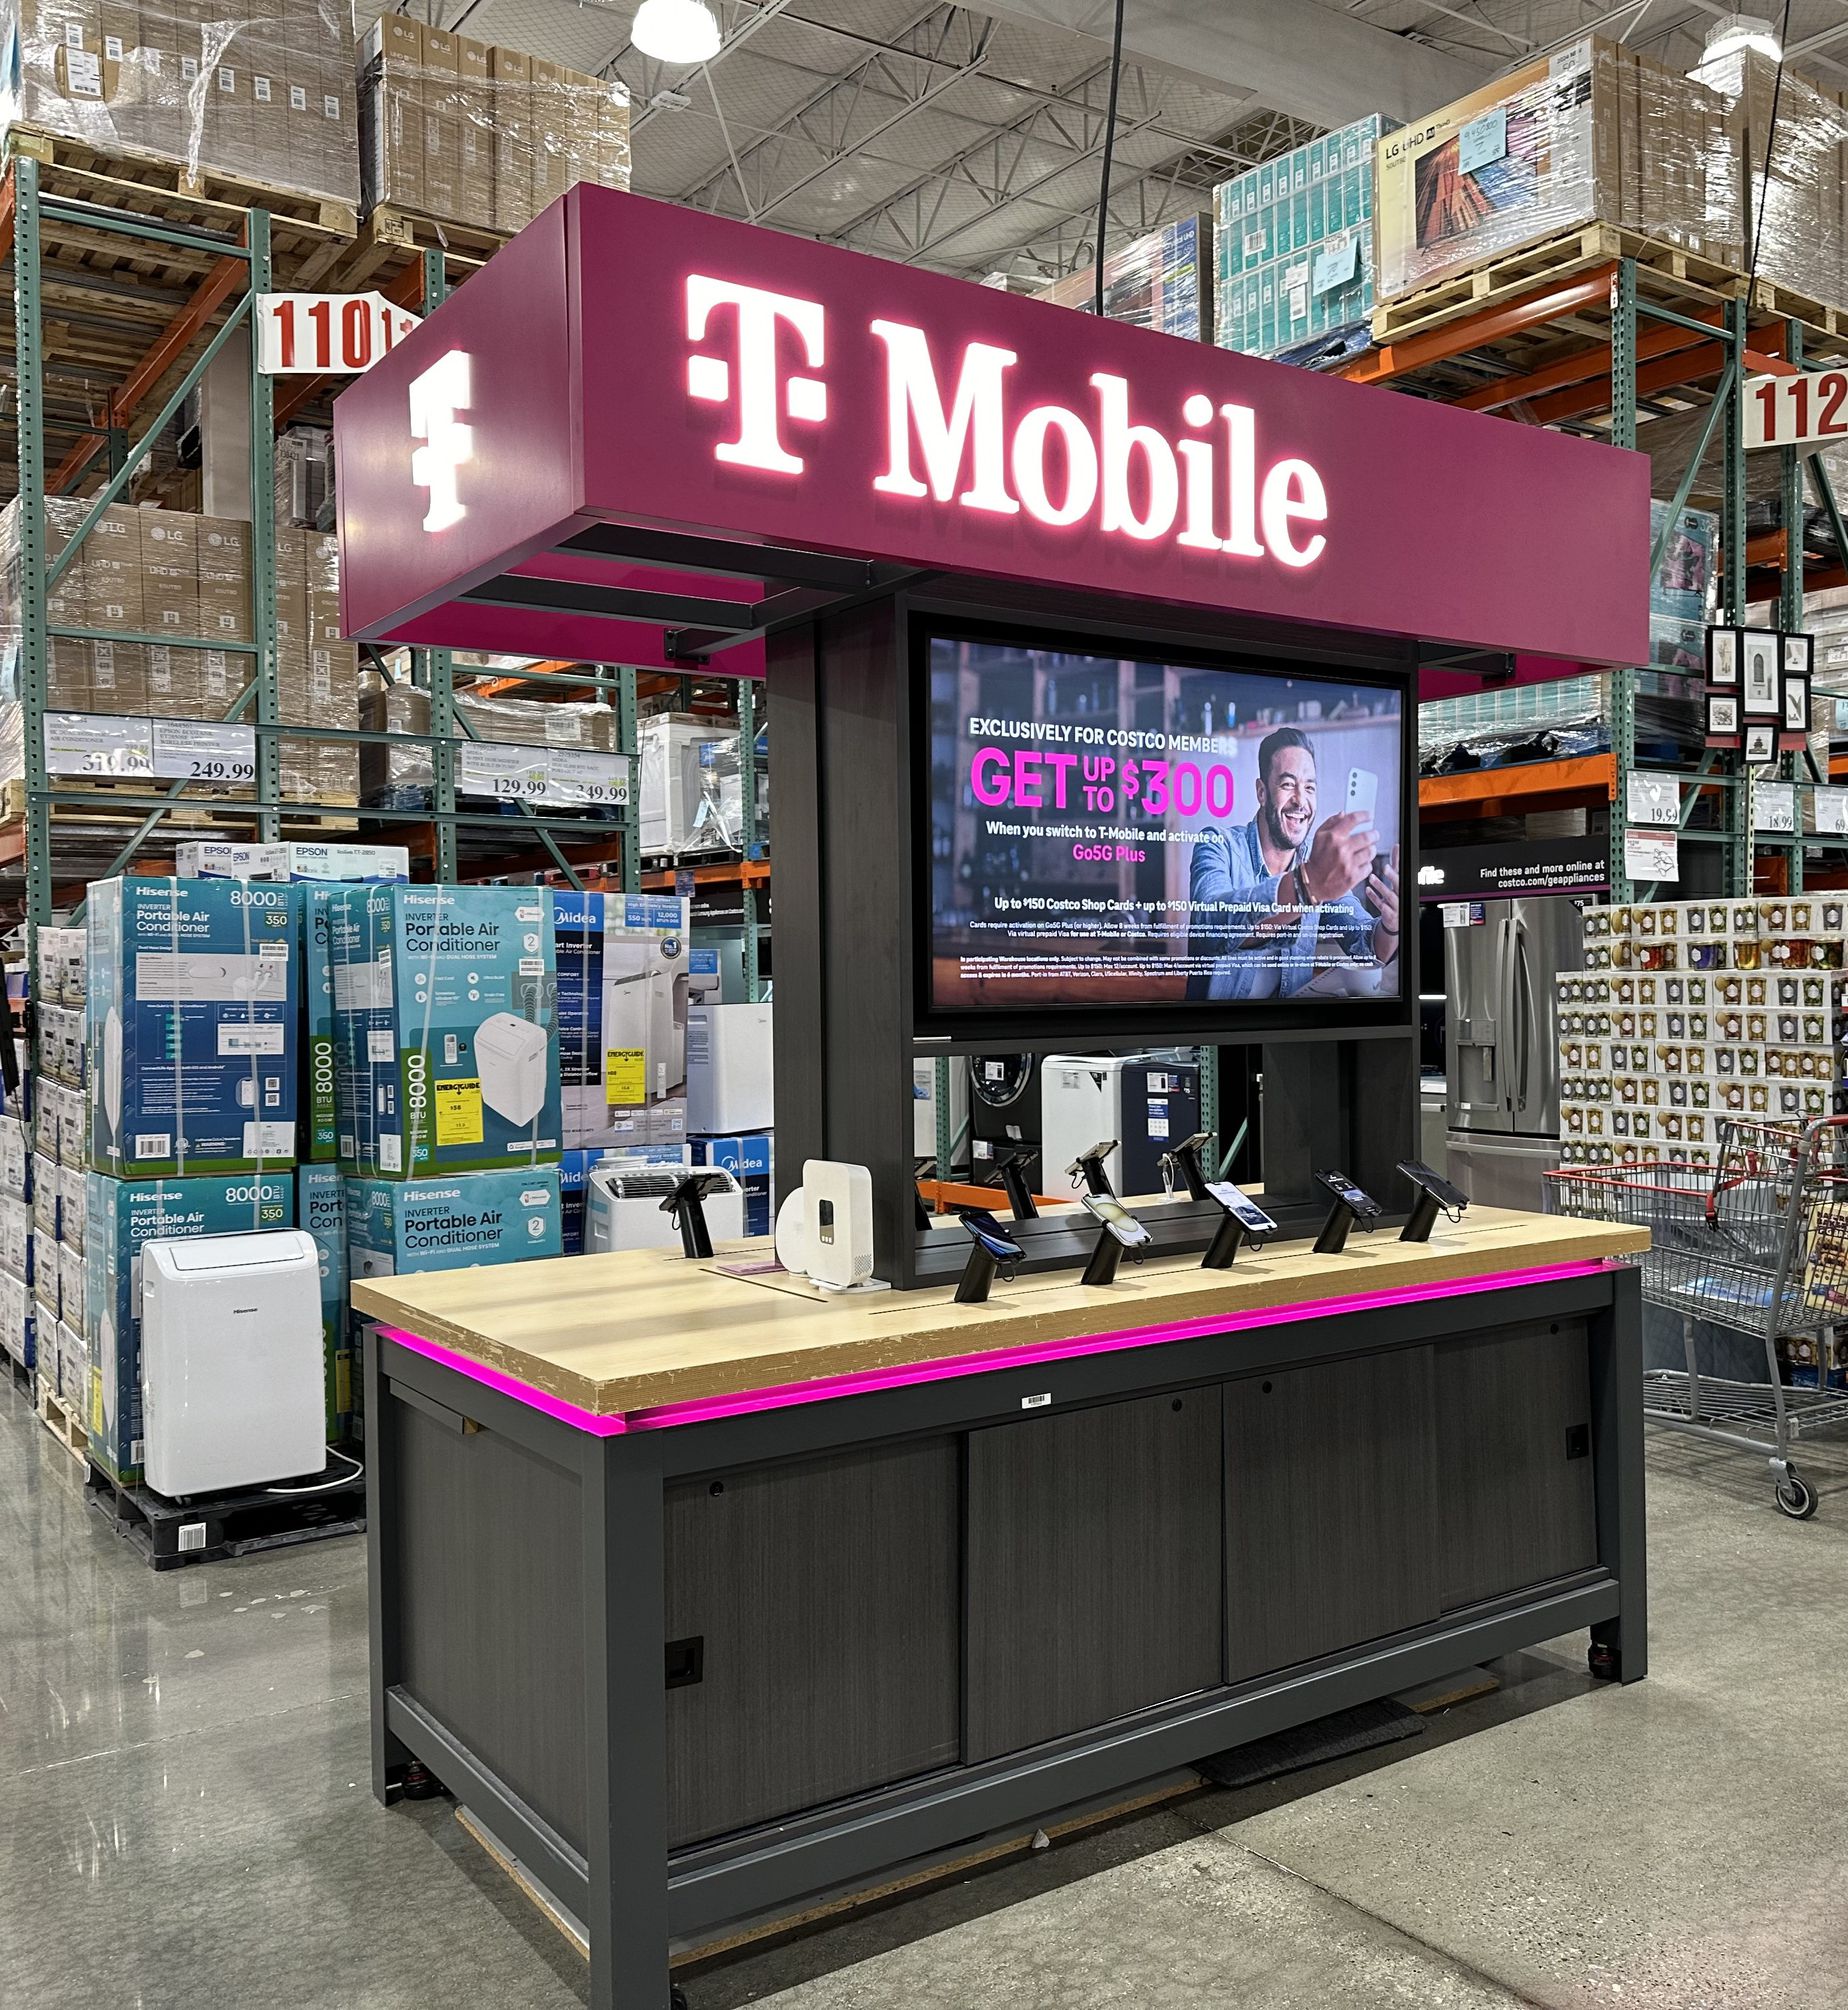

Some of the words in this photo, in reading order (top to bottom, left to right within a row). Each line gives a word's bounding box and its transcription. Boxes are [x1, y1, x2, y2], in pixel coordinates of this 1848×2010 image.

[404, 31, 414, 39] LG
[440, 42, 450, 50] LG
[1386, 144, 1398, 159] LG
[273, 300, 371, 368] 110
[1756, 373, 1848, 441] 112
[685, 274, 827, 475] T
[870, 317, 1329, 569] Mobile
[108, 523, 125, 533] LG
[168, 531, 182, 540] LG
[224, 538, 239, 546] LG
[970, 717, 1072, 742] EXCLUSIVELY
[1074, 726, 1104, 744] FOR
[1107, 729, 1165, 749] COSTCO
[190, 762, 253, 779] 249.99
[1083, 756, 1115, 782] UP
[970, 747, 1077, 809] GET
[493, 779, 546, 795] 129.99
[576, 784, 627, 801] 349.99
[1122, 759, 1234, 818] $300
[1083, 785, 1114, 813] TO
[986, 821, 1021, 835] When
[1022, 825, 1044, 839] you
[1046, 824, 1082, 838] switch
[1085, 826, 1097, 838] to
[1098, 826, 1145, 840] T-Mobile
[1147, 829, 1166, 842] and
[1168, 830, 1210, 843] activate
[1211, 833, 1224, 843] on
[233, 852, 250, 862] EPSON
[297, 848, 327, 856] EPSON
[1072, 844, 1112, 861] Go5G
[1116, 846, 1146, 862] Plus
[1481, 868, 1497, 878] Find
[1499, 866, 1522, 877] these
[1524, 864, 1540, 875] and
[1542, 865, 1563, 874] more
[1566, 861, 1593, 872] online
[1595, 860, 1605, 870] at
[1498, 872, 1605, 888] costco.com/geappliances
[136, 887, 188, 897] Hisense
[230, 891, 277, 906] 8000
[404, 895, 455, 904] Hisense
[367, 898, 385, 913] 8000
[995, 897, 1008, 911] Up
[1010, 898, 1022, 909] to
[1023, 898, 1045, 909] $150
[1046, 898, 1080, 910] Costco
[1082, 899, 1106, 912] Shop
[1107, 899, 1134, 911] Cards
[1143, 901, 1155, 912] up
[1156, 900, 1166, 911] to
[1168, 901, 1187, 911] $150
[1188, 901, 1218, 912] Virtual
[1219, 902, 1251, 914] Prepaid
[1252, 902, 1270, 912] Visa
[1271, 902, 1291, 913] Card
[1292, 903, 1314, 913] when
[1315, 903, 1354, 915] activating
[137, 911, 189, 921] Portable
[192, 911, 209, 921] Air
[266, 916, 287, 924] 350
[555, 907, 596, 924] Midea
[137, 922, 209, 932] Conditioner
[406, 923, 474, 936] Porable
[479, 922, 499, 936] Air
[1037, 930, 1057, 938] prepaid
[407, 937, 500, 951] Conditioner
[528, 937, 535, 946] 2
[315, 1043, 333, 1092] 8000
[408, 1055, 426, 1108] 8000
[130, 1192, 183, 1202] Hisense
[226, 1186, 273, 1202] 8000
[404, 1188, 461, 1201] Hisense
[131, 1214, 185, 1226] Portable
[187, 1212, 204, 1223] Air
[262, 1209, 283, 1219] 350
[405, 1206, 450, 1218] INVERTER
[405, 1214, 476, 1232] Portable
[479, 1211, 502, 1224] Air
[532, 1220, 540, 1230] 2
[131, 1224, 204, 1237] Conditioner
[405, 1227, 503, 1249] Conditioner
[479, 1242, 499, 1250] SYSTEM
